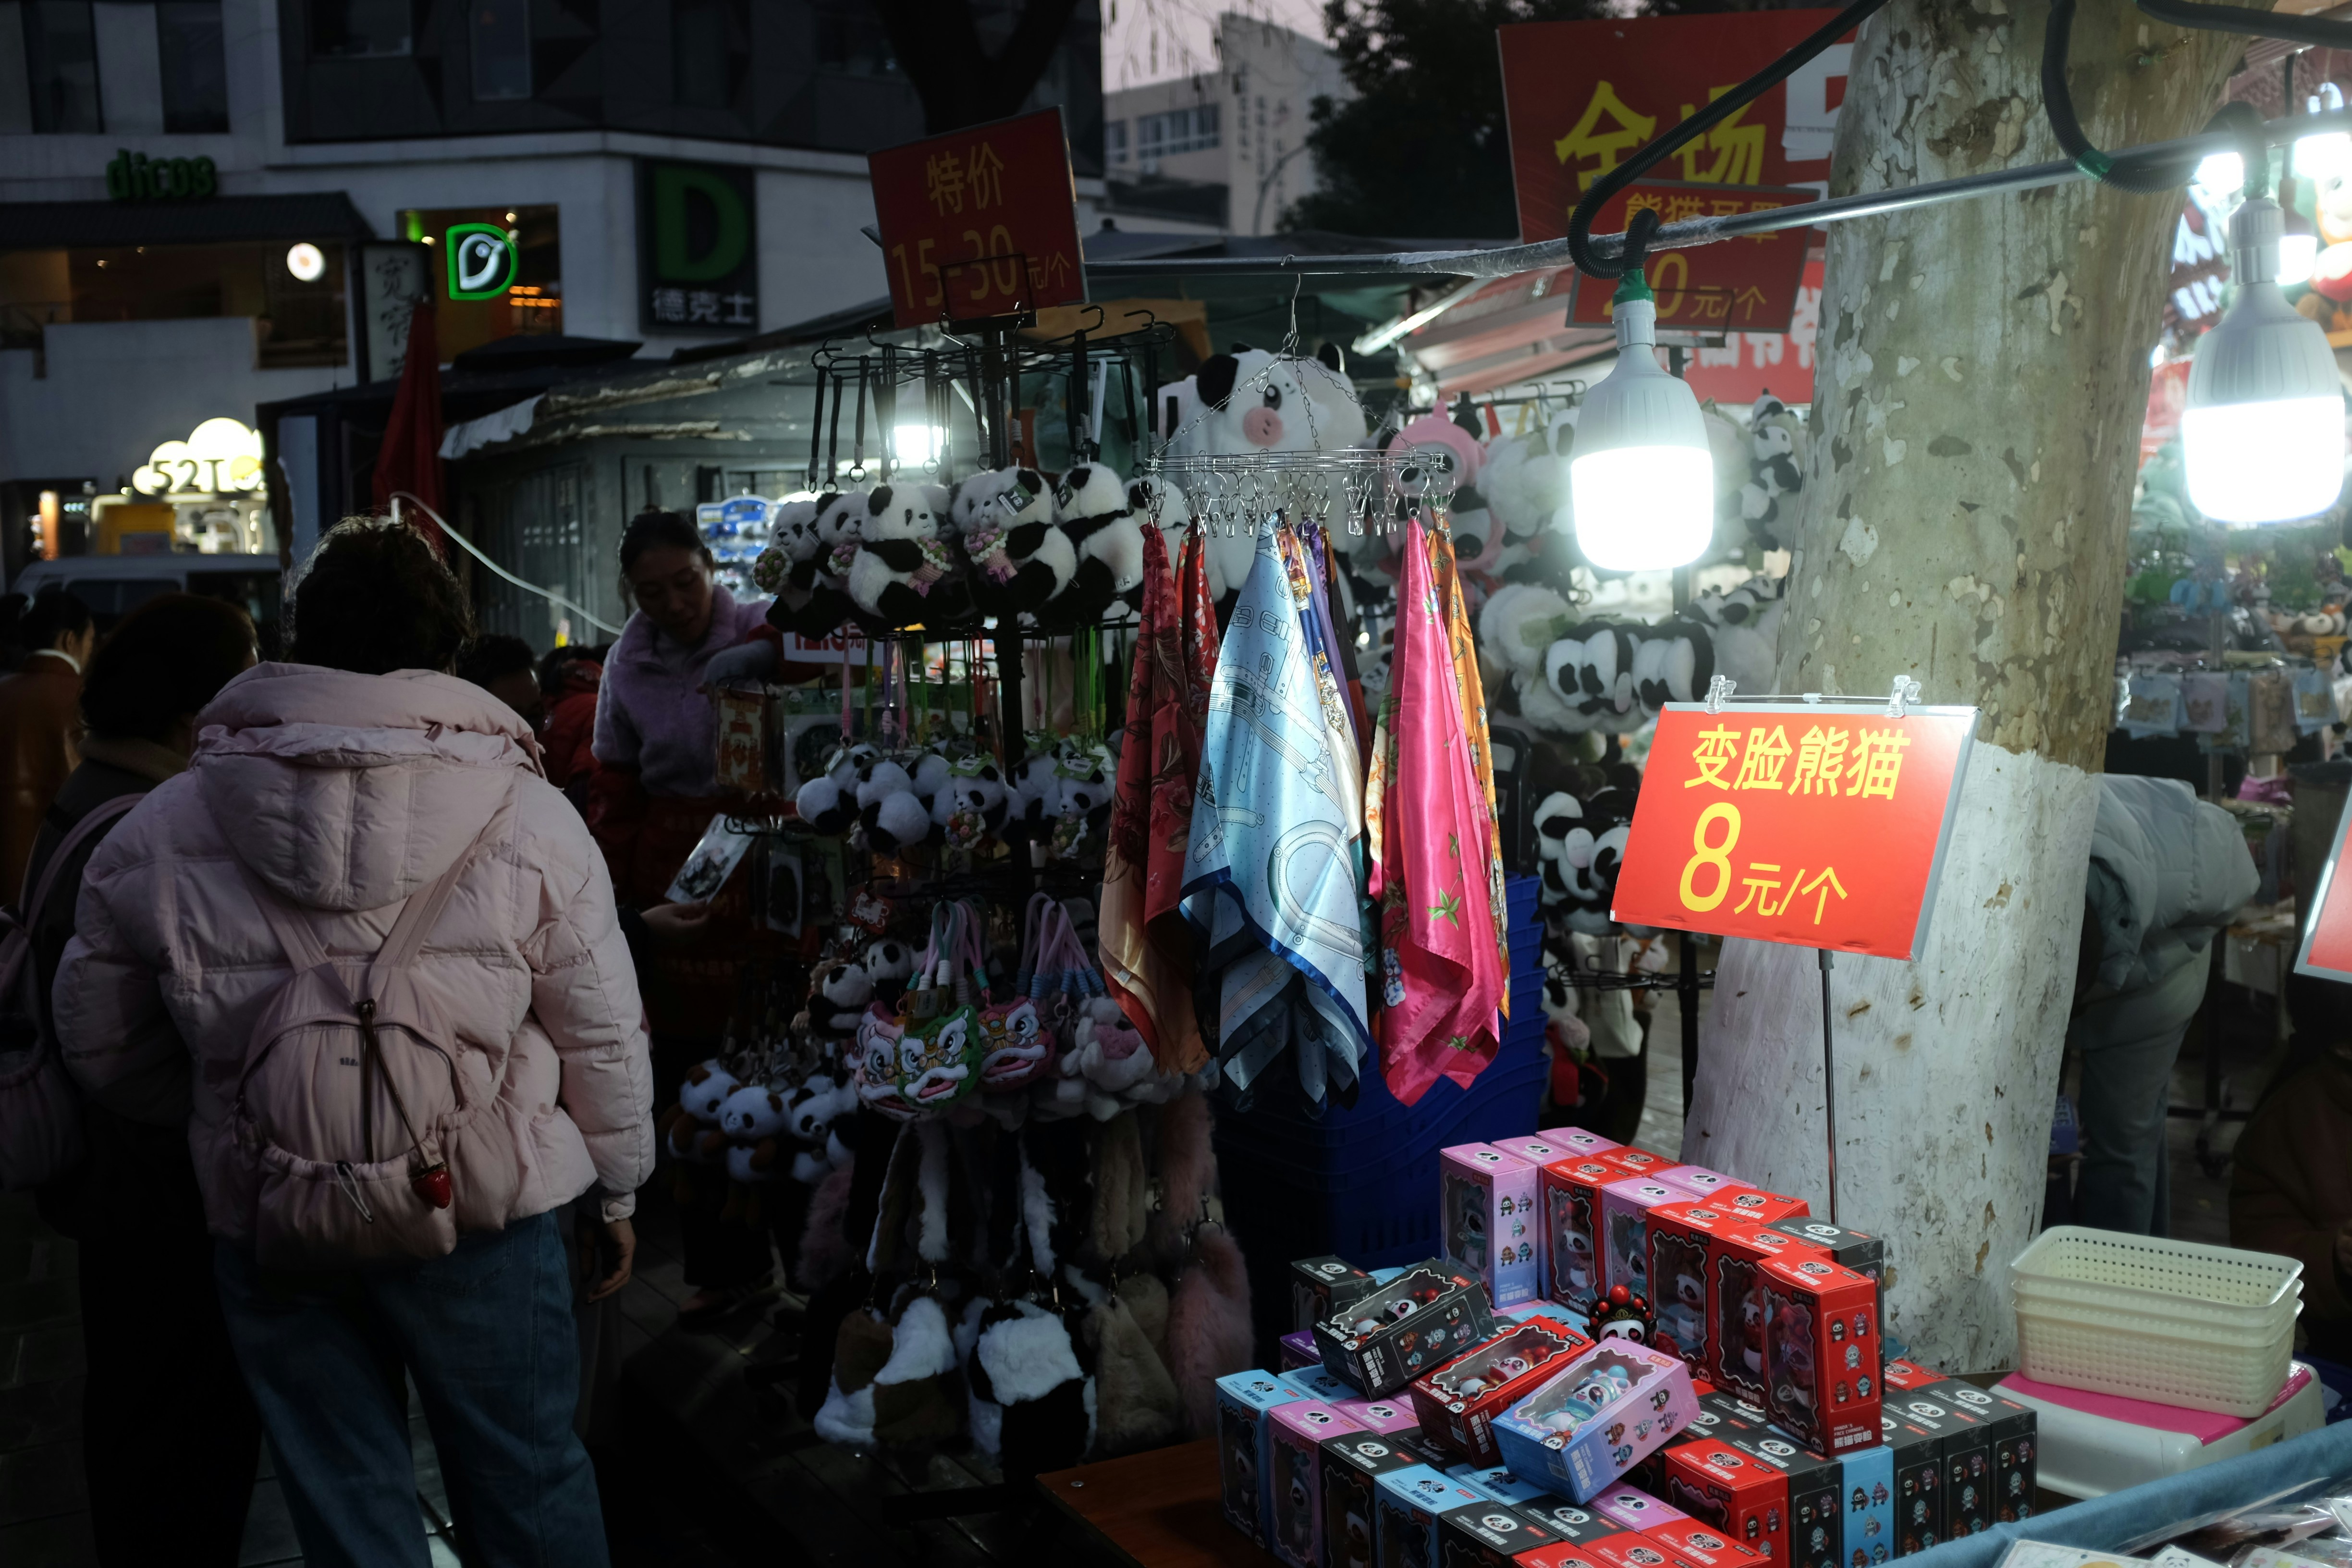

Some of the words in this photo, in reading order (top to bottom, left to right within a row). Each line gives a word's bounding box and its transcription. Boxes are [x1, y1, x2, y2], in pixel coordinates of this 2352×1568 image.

[107, 148, 216, 199] dicos
[926, 142, 1005, 218] 特价
[654, 165, 748, 282] D
[1684, 723, 1911, 800] 变脸熊猫
[1679, 802, 1848, 925] 8元/个
